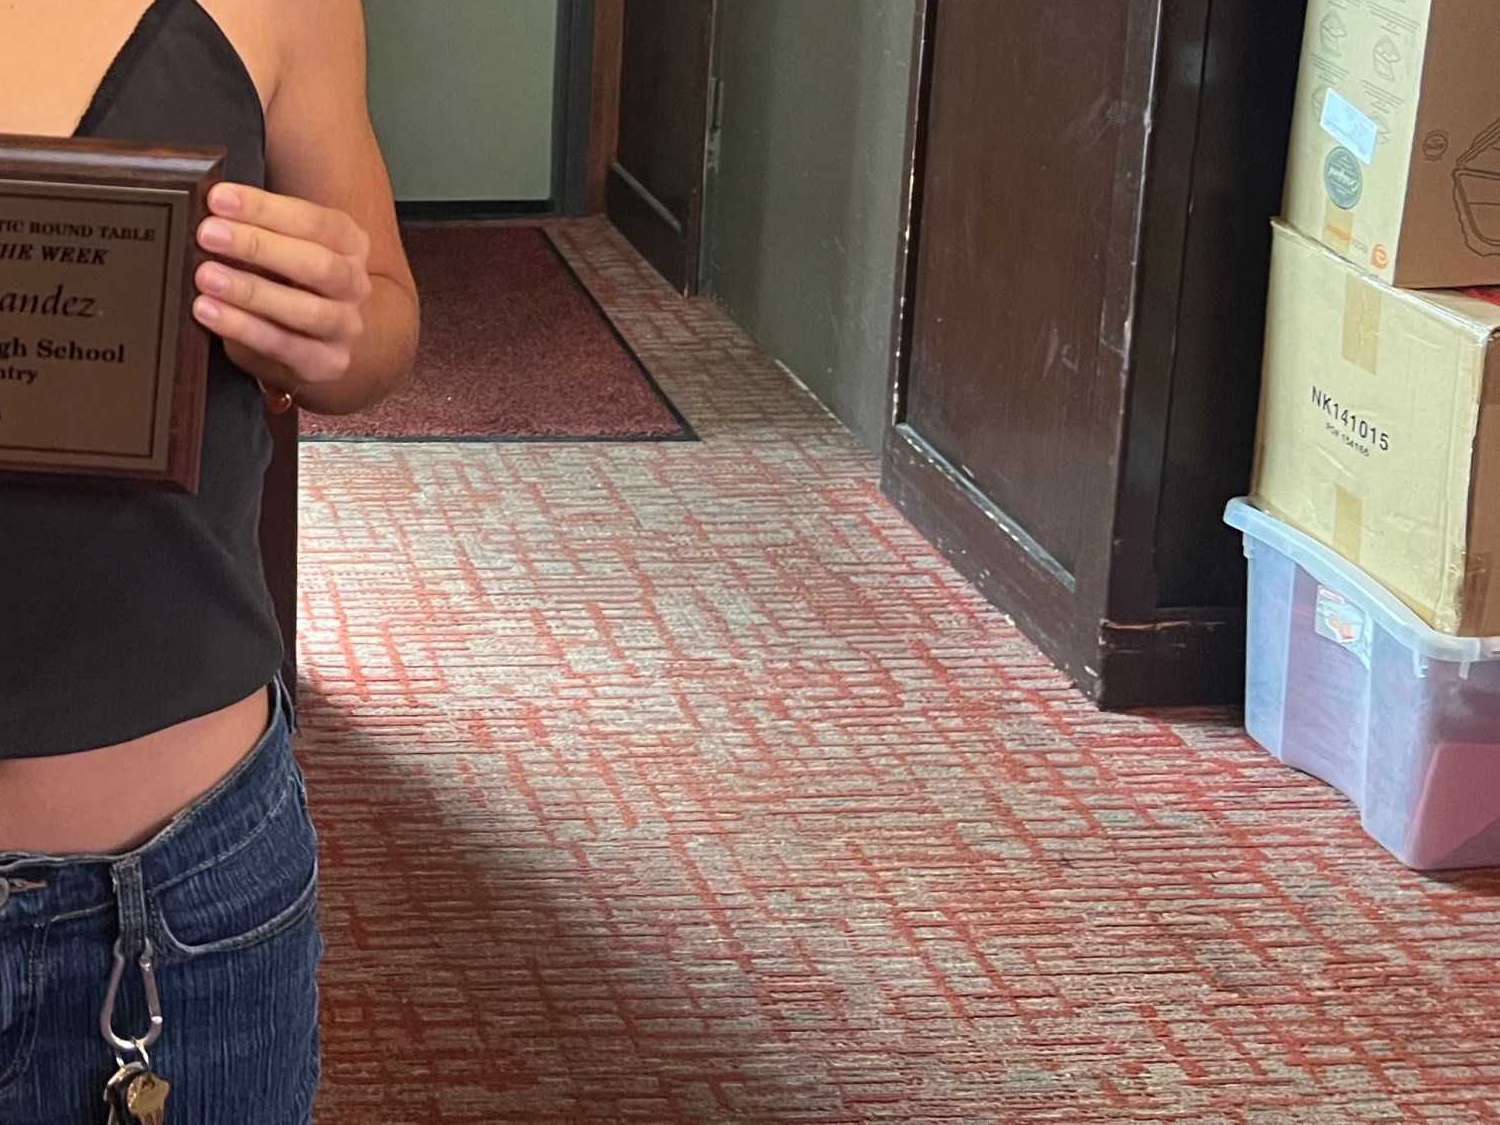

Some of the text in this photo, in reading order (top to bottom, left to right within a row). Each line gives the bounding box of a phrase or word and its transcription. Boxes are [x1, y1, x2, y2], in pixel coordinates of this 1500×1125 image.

[29, 221, 93, 238] ROUND
[98, 226, 156, 242] TABLE
[40, 245, 109, 265] WEEK
[36, 338, 126, 364] School
[1311, 385, 1389, 451] NK141015
